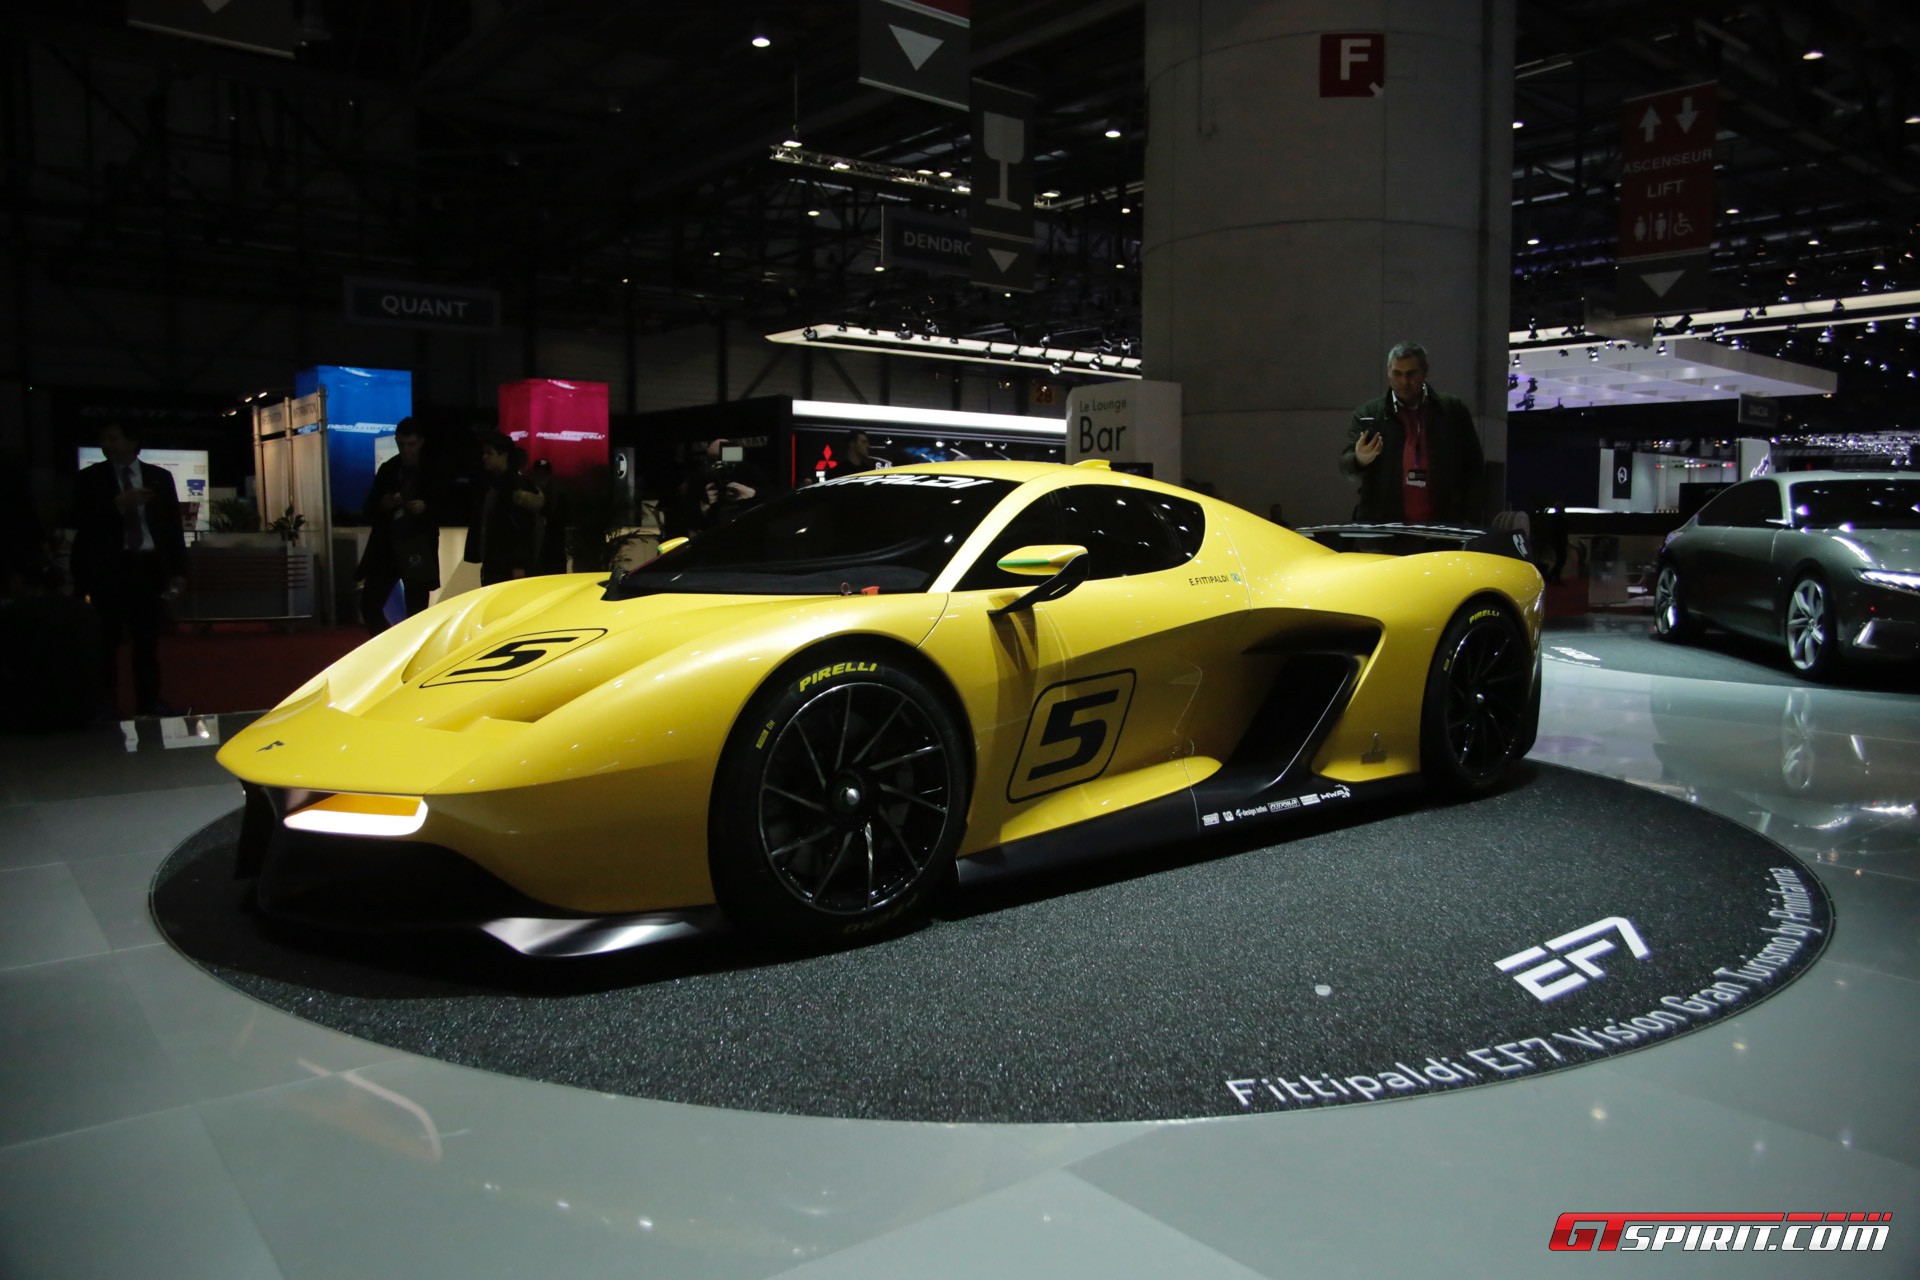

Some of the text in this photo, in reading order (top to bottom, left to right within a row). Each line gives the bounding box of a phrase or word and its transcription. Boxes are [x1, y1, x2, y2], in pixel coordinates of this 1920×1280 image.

[1340, 38, 1372, 81] F
[1623, 149, 1712, 175] ASCENSEUR
[1647, 180, 1684, 198] LIFT
[381, 295, 469, 318] QUANT
[1036, 386, 1052, 404] 28
[1080, 399, 1127, 413] Le Lounge
[1080, 416, 1126, 453] Bar
[1468, 609, 1500, 625] PIRELLI
[445, 637, 580, 677] 5
[800, 661, 877, 693] PIRELLI
[1027, 688, 1120, 782] 5
[1493, 916, 1651, 1003] EF7
[1226, 1056, 1477, 1107] Fittipaldi
[1466, 1036, 1564, 1073] EF7
[1551, 1009, 1688, 1050] Vision
[1660, 981, 1749, 1016] Gran
[1713, 937, 1802, 982] Turismo
[1760, 920, 1822, 937] by
